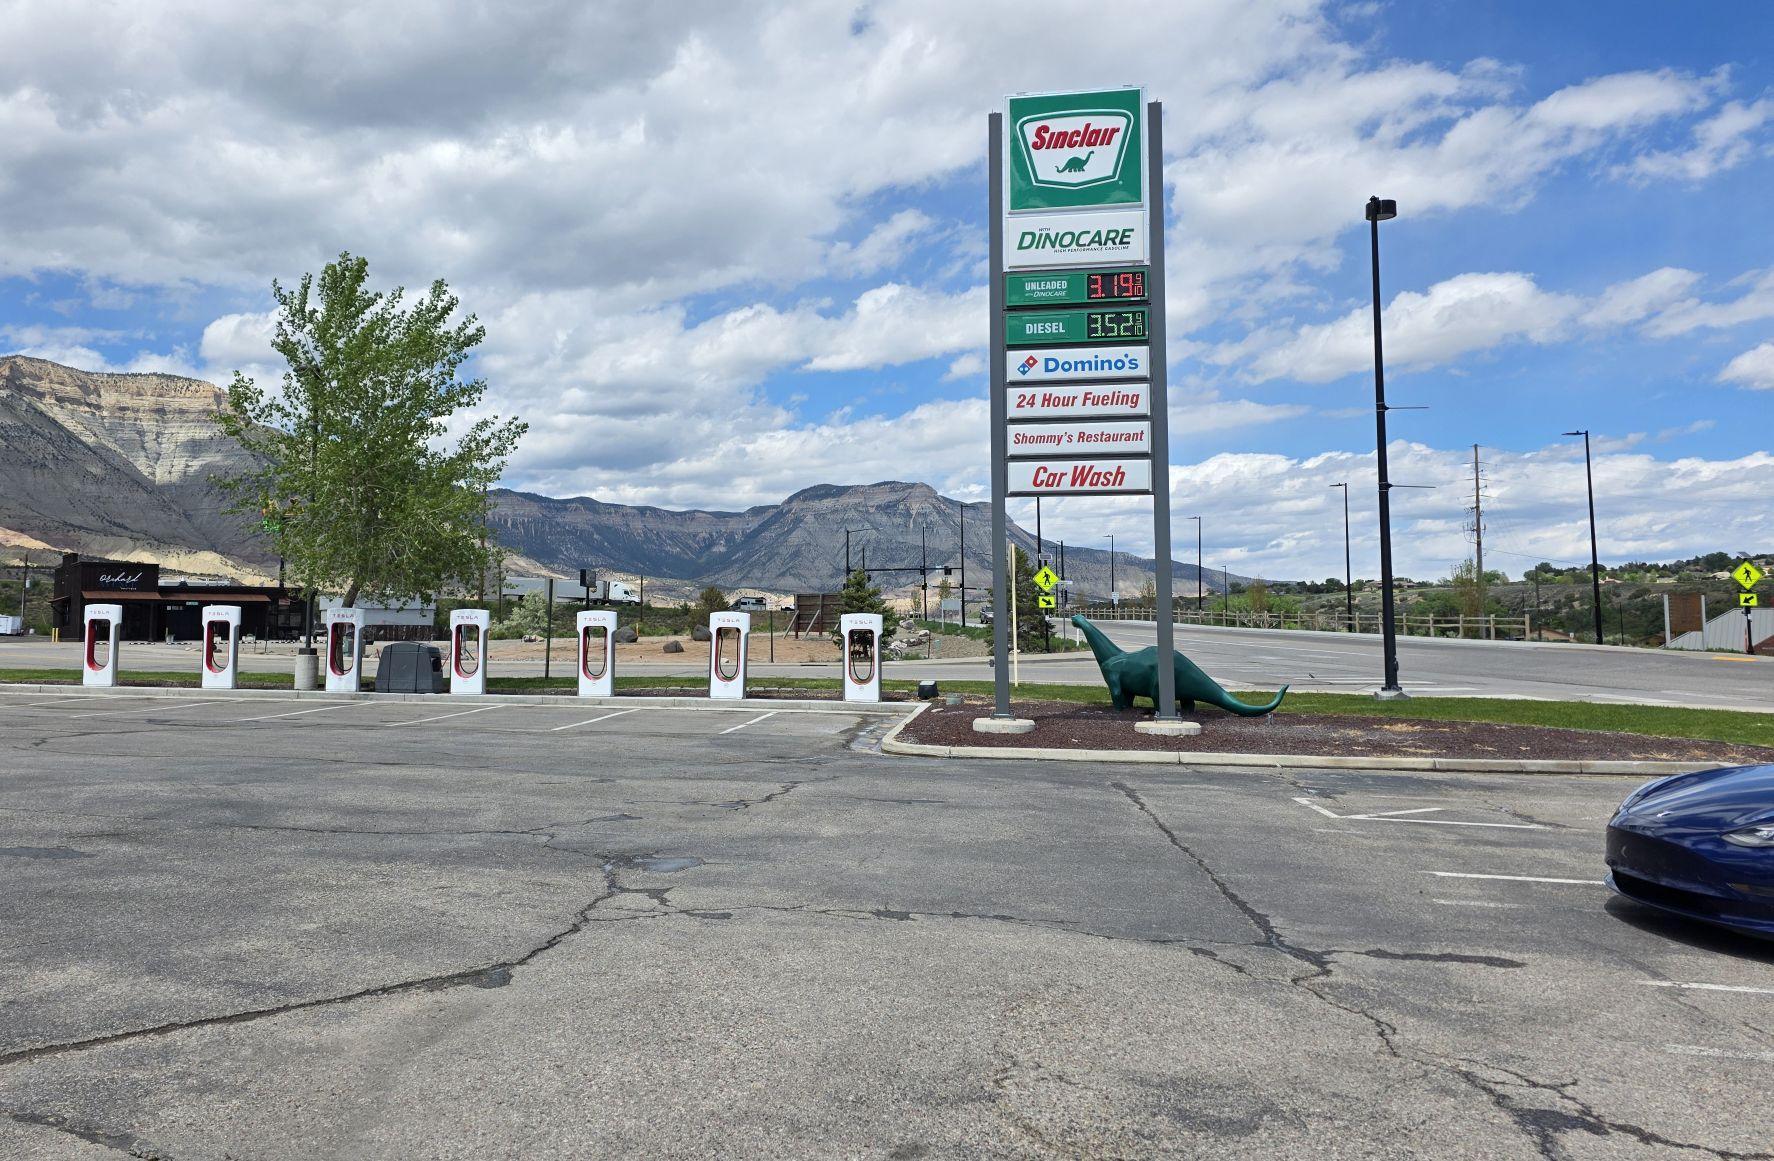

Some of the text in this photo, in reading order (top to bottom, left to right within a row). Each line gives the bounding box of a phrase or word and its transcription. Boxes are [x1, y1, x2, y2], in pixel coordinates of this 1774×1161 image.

[1032, 123, 1120, 150] Sinclair
[1017, 228, 1134, 250] DINOCARE
[1025, 280, 1067, 290] UNLEADED
[1025, 322, 1065, 334] DIESEL
[1044, 353, 1139, 372] Domino's
[1016, 391, 1140, 408] 24 Hour Fueling
[1014, 430, 1144, 446] Shommy's Restaurant
[1032, 465, 1126, 487] Car Wash
